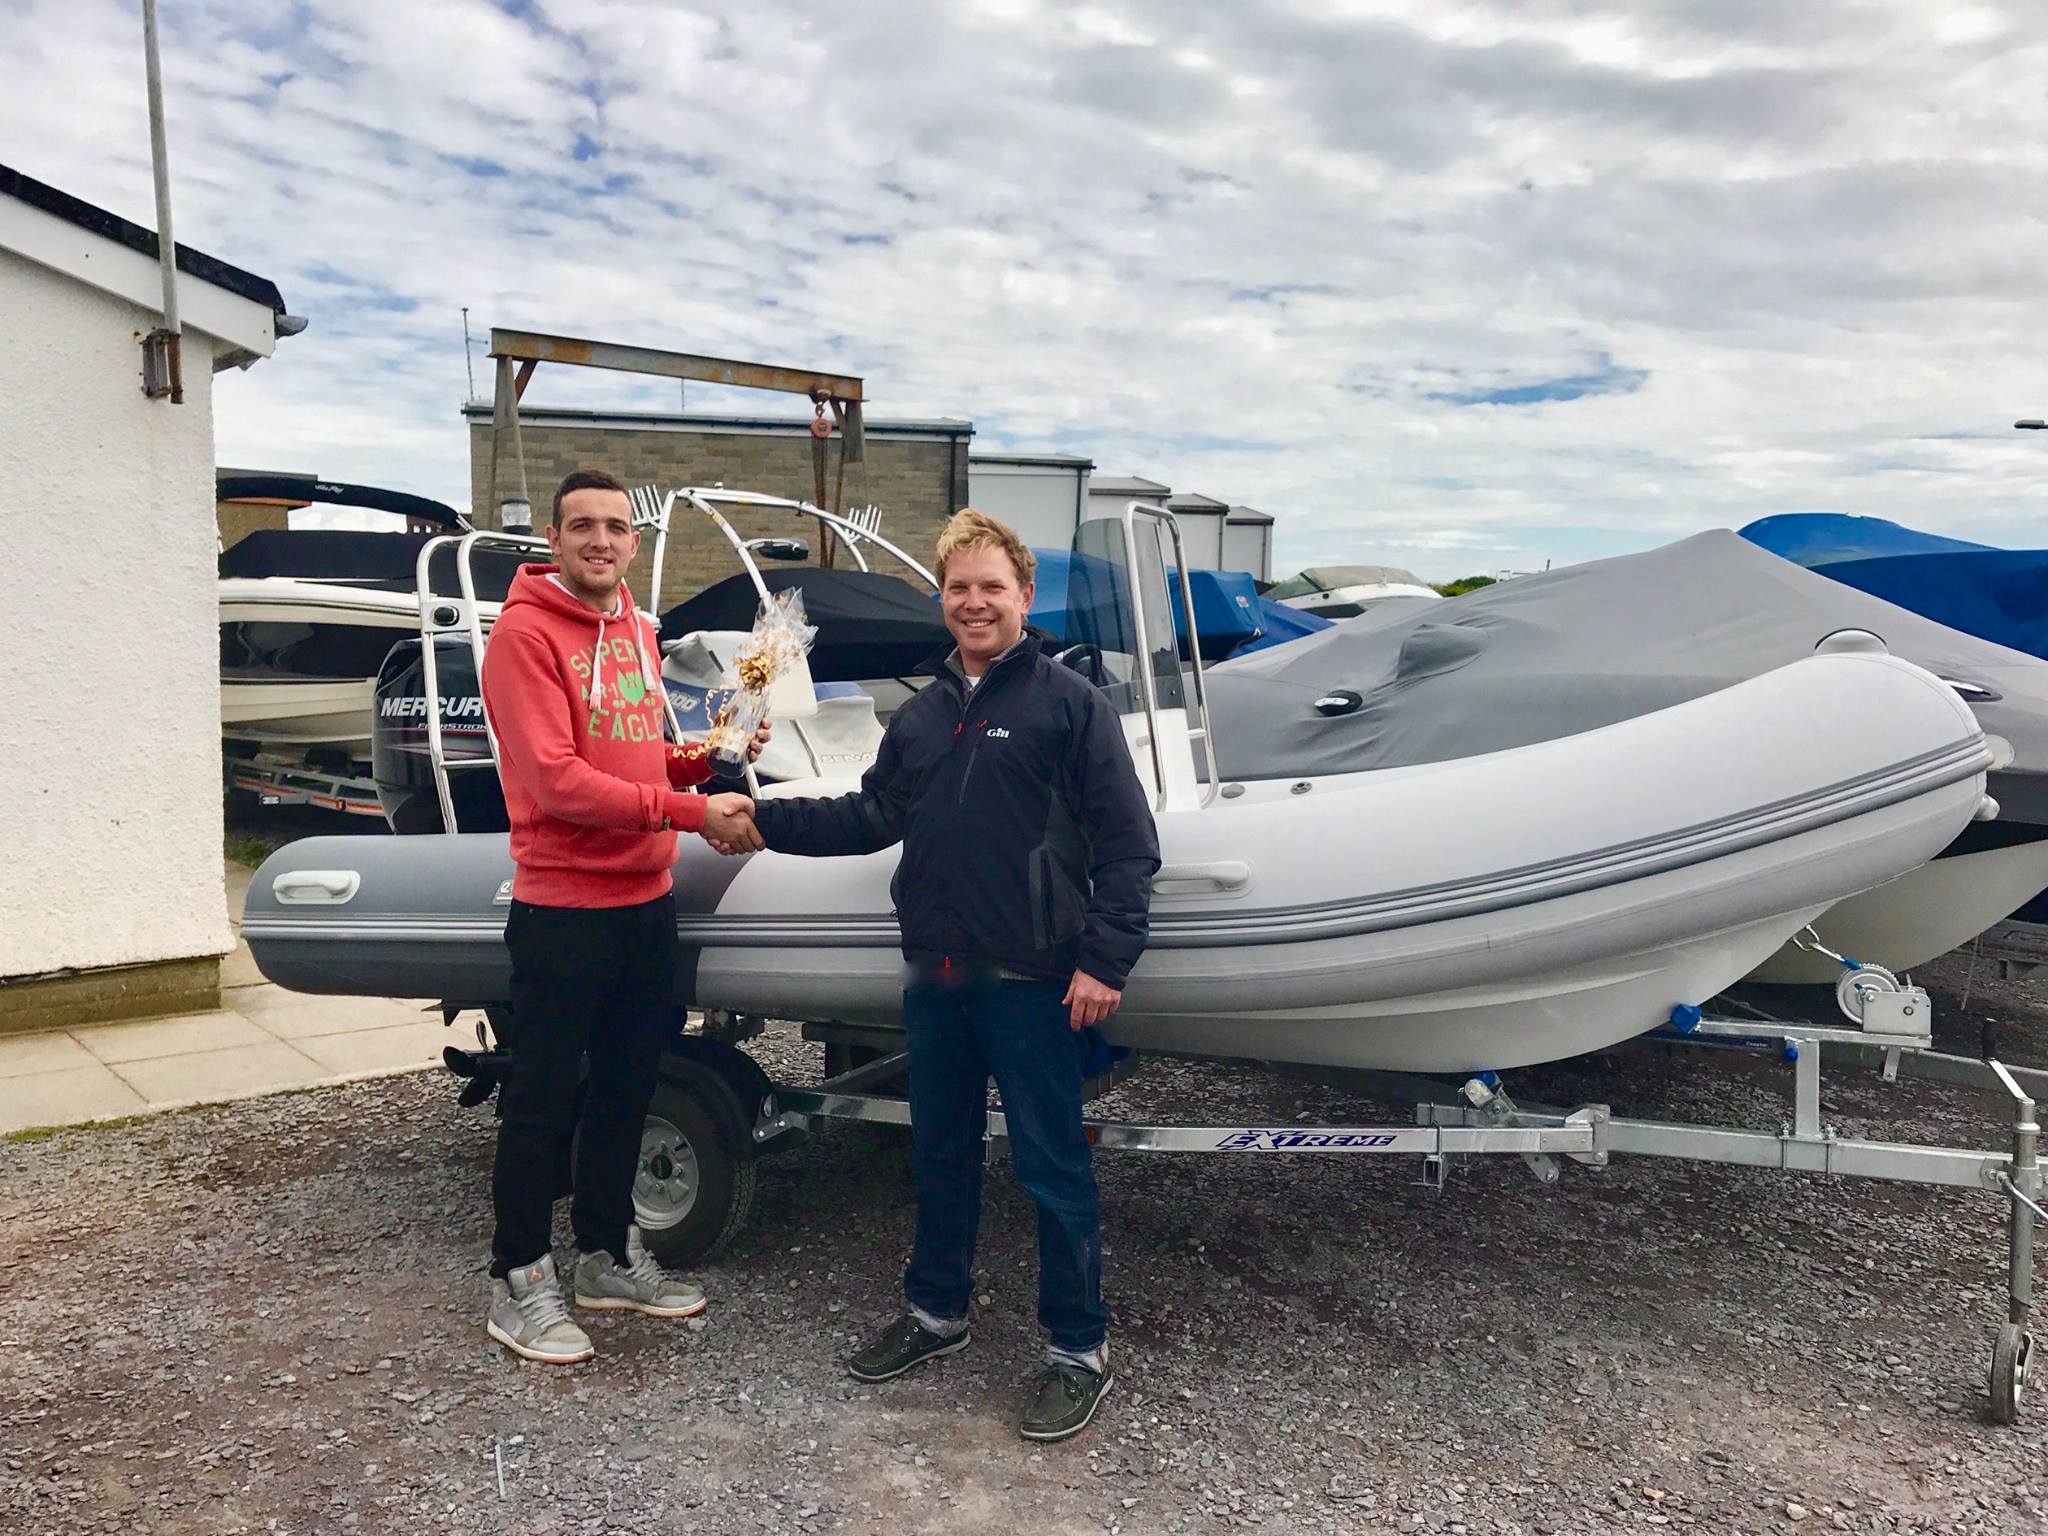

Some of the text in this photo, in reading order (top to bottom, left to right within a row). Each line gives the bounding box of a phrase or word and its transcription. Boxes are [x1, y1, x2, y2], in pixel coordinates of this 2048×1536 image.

[570, 638, 651, 679] SUPER
[380, 697, 484, 717] MERCUR
[587, 708, 664, 742] EAGLE
[986, 728, 1010, 738] Gill
[1215, 1130, 1398, 1150] EXTREME
